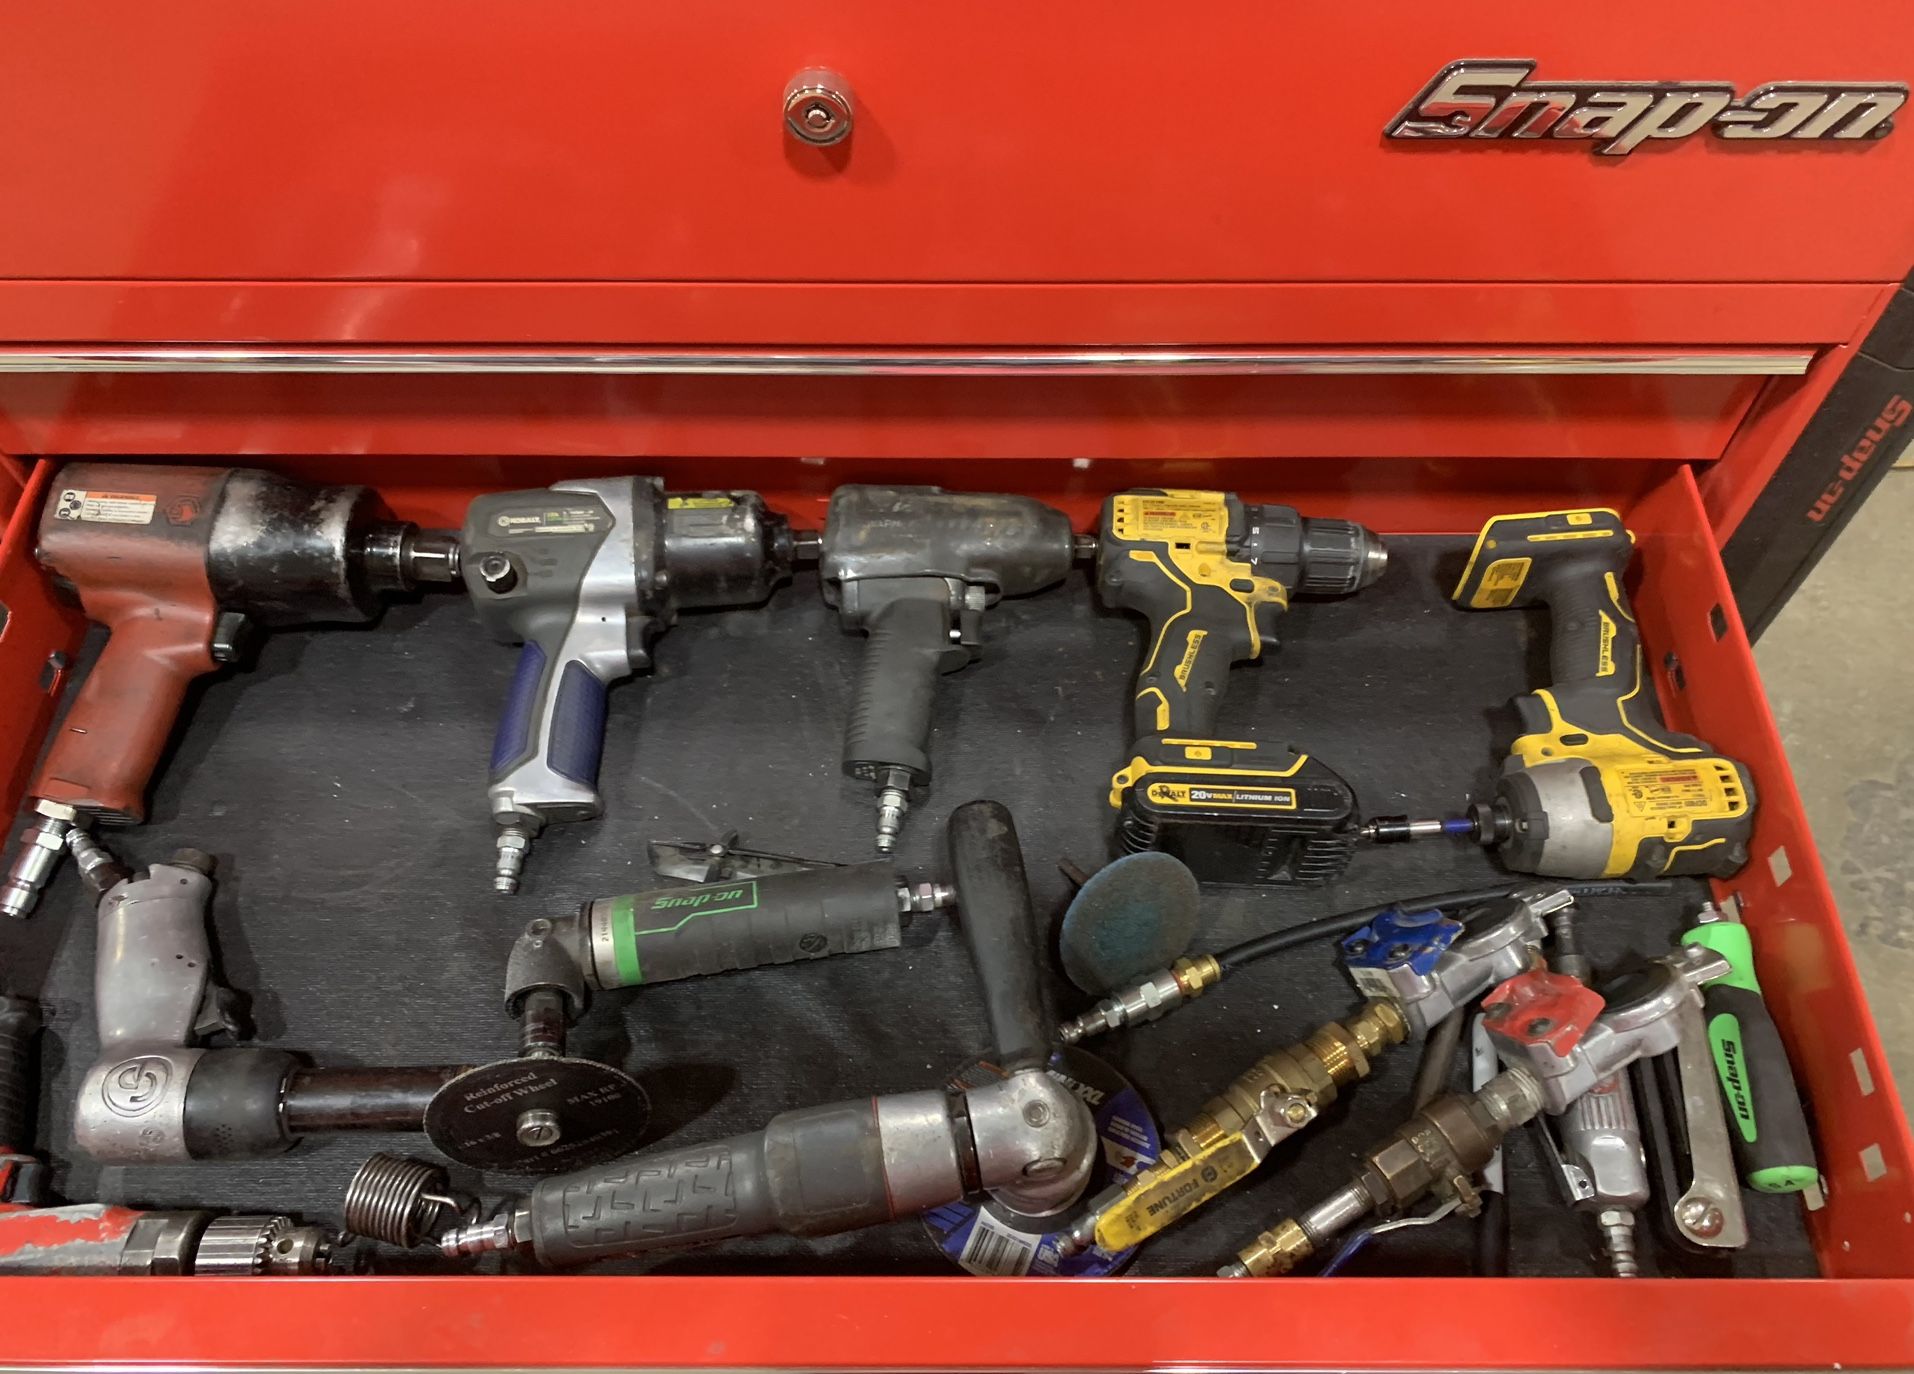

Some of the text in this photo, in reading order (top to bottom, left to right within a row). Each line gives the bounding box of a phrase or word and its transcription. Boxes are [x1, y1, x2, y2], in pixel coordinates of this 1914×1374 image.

[1387, 60, 1908, 155] Snap-on
[1806, 394, 1913, 522] Snap-on
[1179, 633, 1202, 681] BRUSHLESS
[1601, 621, 1611, 673] BRUSHLESS
[1236, 793, 1272, 802] LITHIUM
[651, 888, 743, 911] Snap-on
[464, 1072, 539, 1102] Reinforced
[464, 1078, 558, 1114] Cut-off Wheel
[1720, 1038, 1750, 1121] Snap-on
[1146, 1178, 1200, 1217] FORTUNE
